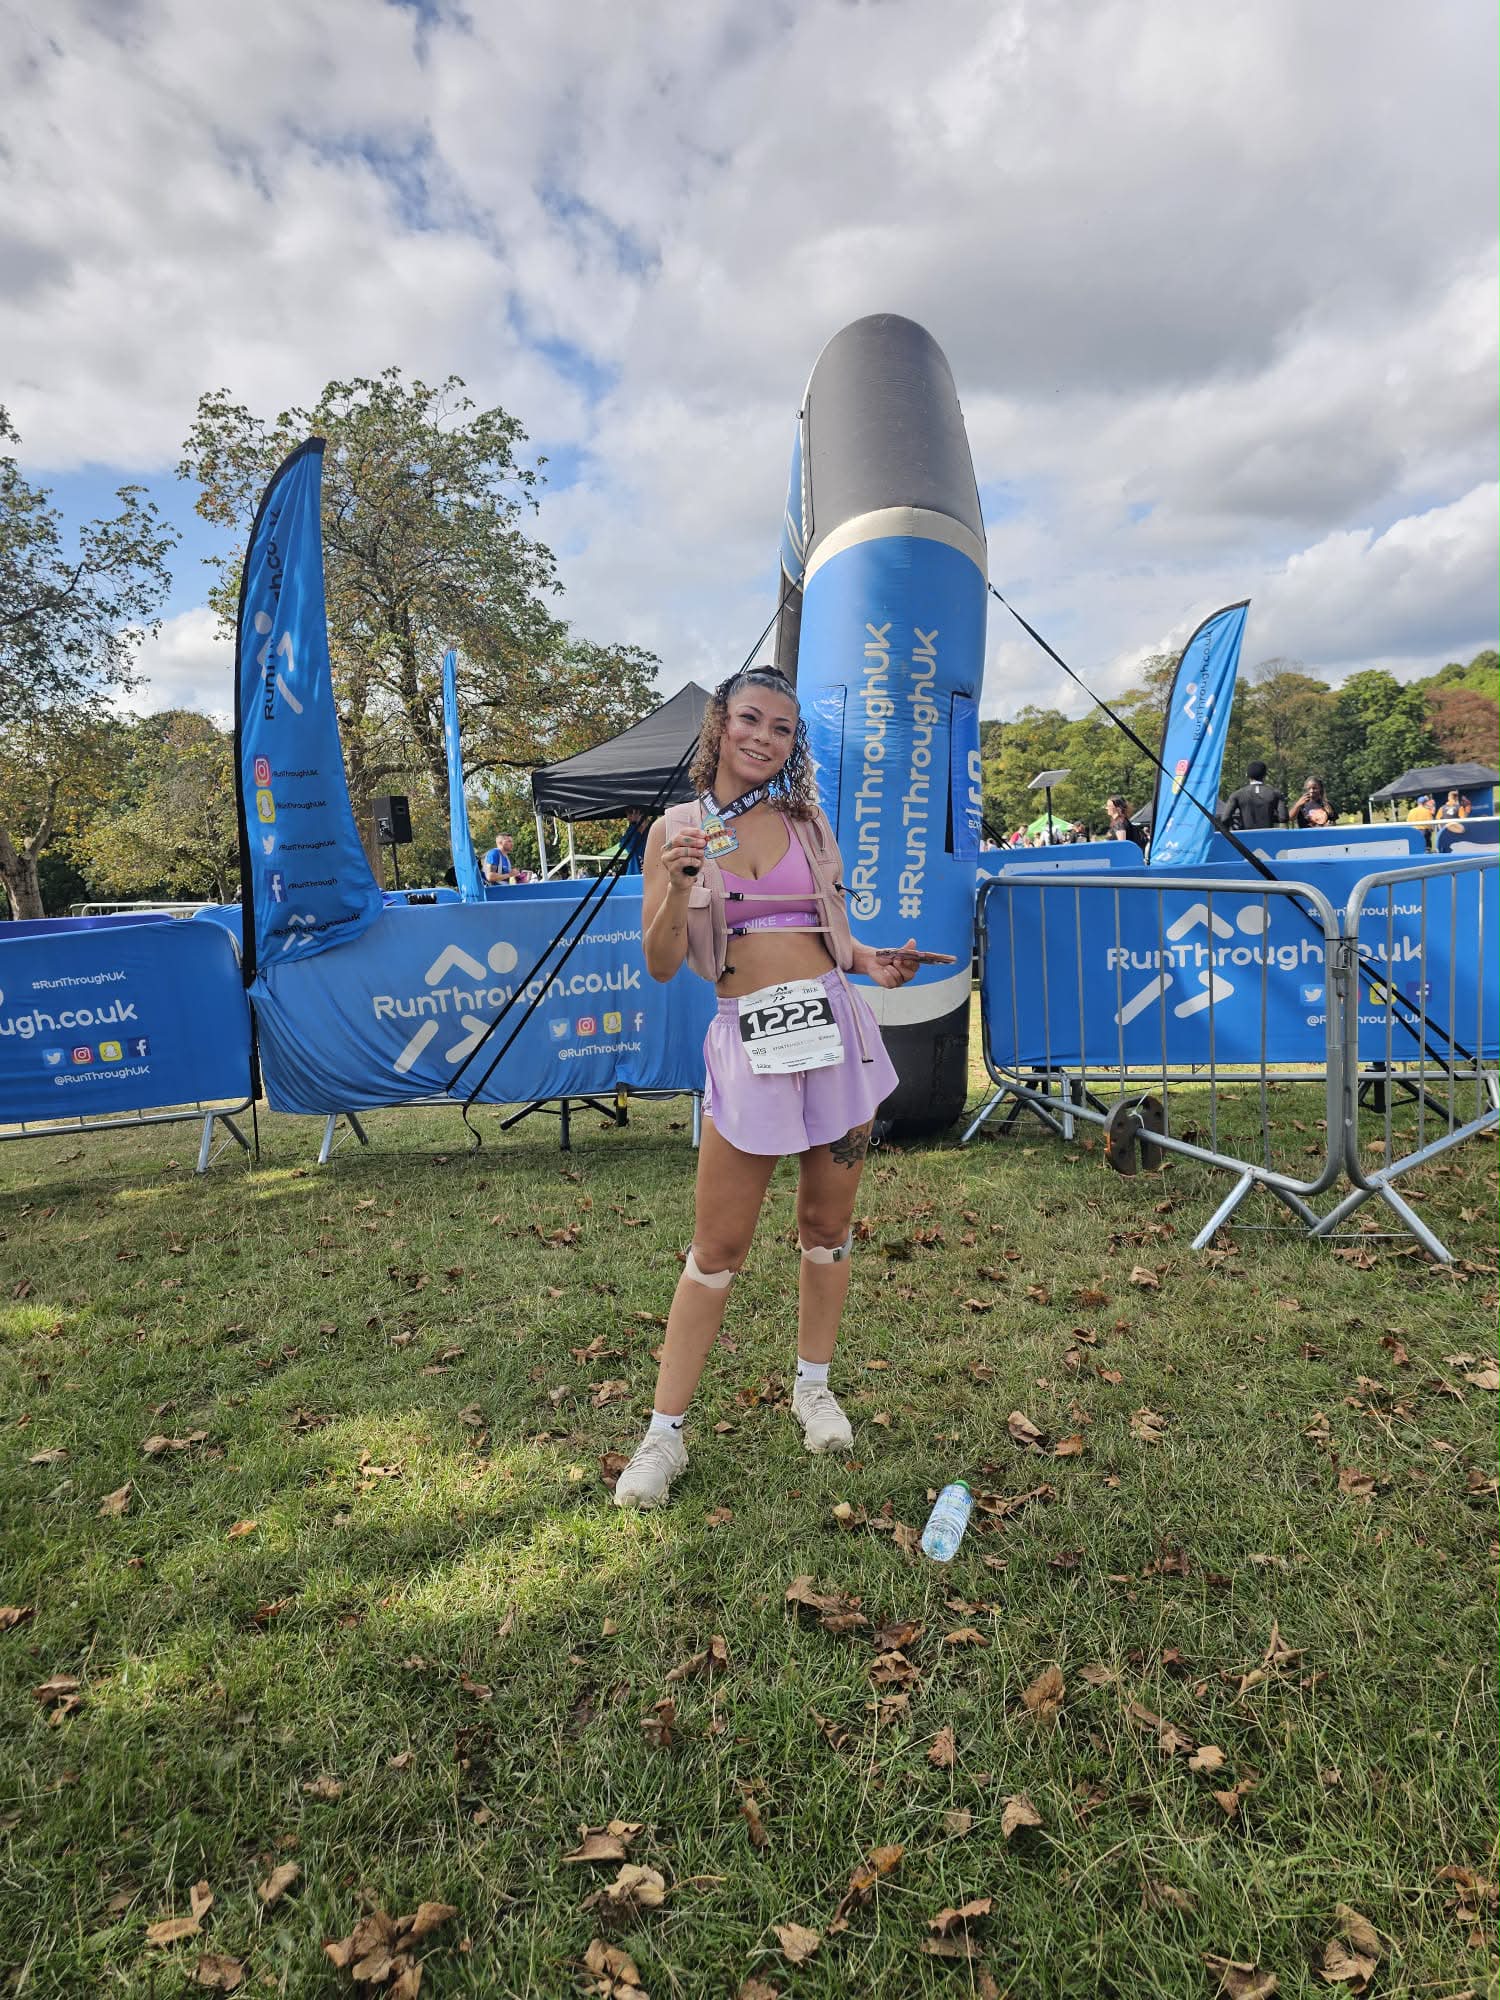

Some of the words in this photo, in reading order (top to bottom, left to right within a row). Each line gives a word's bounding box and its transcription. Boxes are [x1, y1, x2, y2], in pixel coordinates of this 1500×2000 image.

[851, 622, 894, 921] @RunThroughUK
[898, 627, 939, 920] #RunThroughUK
[744, 916, 777, 929] NIKE
[32, 970, 127, 990] #RunThroughUK
[747, 1000, 828, 1039] 1222
[558, 1041, 641, 1061] @RunThroughUK
[54, 1064, 151, 1086] @RunThroughUK
